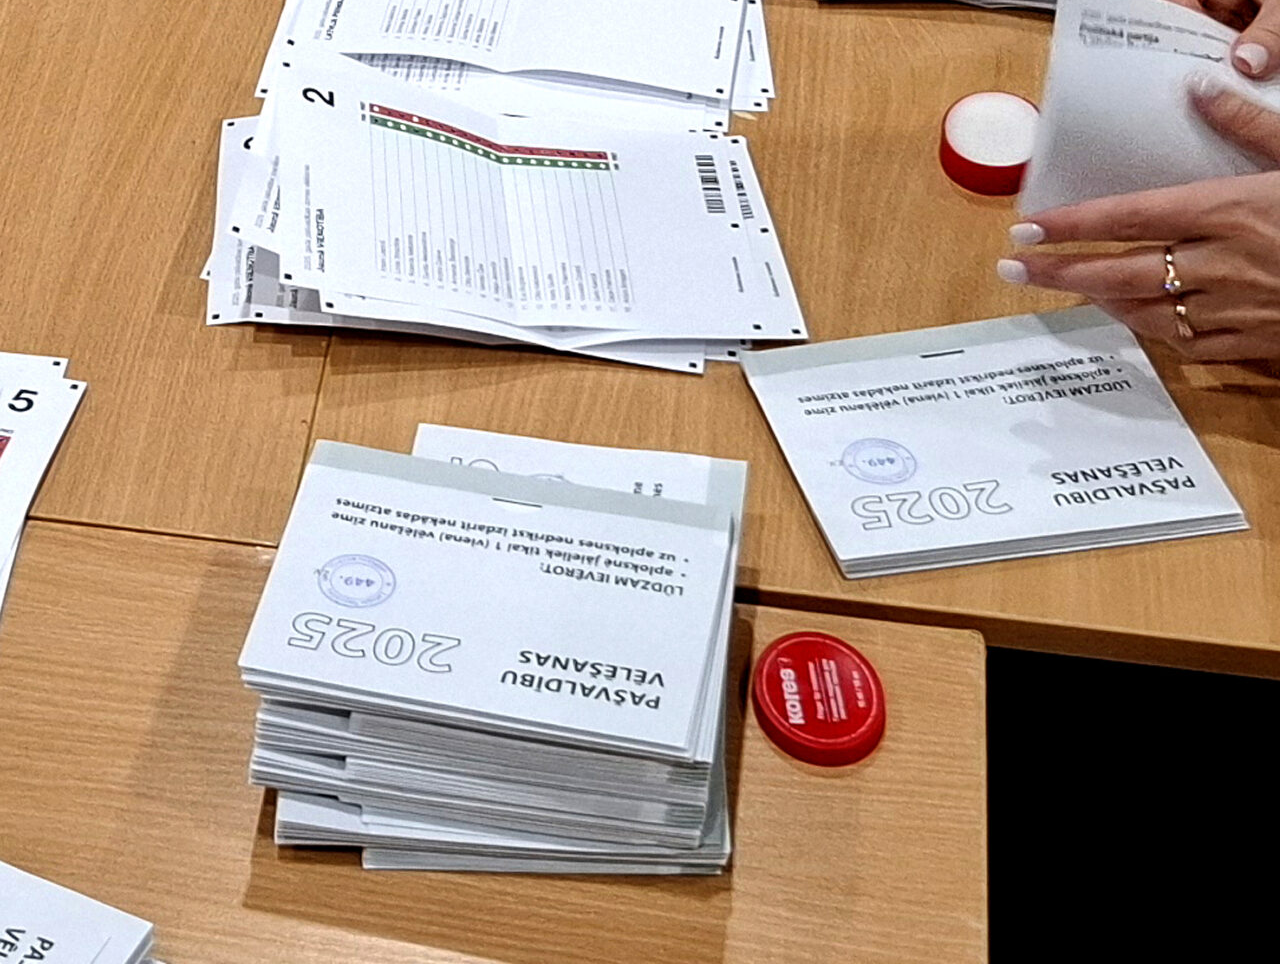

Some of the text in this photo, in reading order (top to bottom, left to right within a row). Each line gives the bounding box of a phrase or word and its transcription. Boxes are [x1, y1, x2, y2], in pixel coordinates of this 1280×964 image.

[302, 86, 335, 107] 2
[1019, 356, 1085, 375] aploksnes
[1087, 354, 1104, 365] uz
[7, 389, 39, 413] 5
[902, 388, 951, 406] (viena)
[953, 389, 961, 398] 1
[963, 382, 996, 397] tikai
[1070, 378, 1132, 396] LŪDZAM
[839, 396, 900, 415] vēlēšanu
[1050, 455, 1183, 486] VĒLĒŠANAS
[849, 479, 1012, 531] 2025
[1051, 474, 1196, 508] PAŠVALDĪBU
[330, 511, 674, 577] aploksnē jāieliek tikai 1 (viena) vēlēšanu zīme
[335, 497, 676, 564] uz aploksnes nedrīkst izdarīt nekādas atzīmes
[538, 562, 684, 597] LŪDZAM IEVĒROT:
[287, 611, 461, 674] 2025
[518, 649, 666, 689] VĒLĒŠANAS
[500, 668, 661, 710] PAŠVALDĪBU
[20, 936, 55, 964] PA
